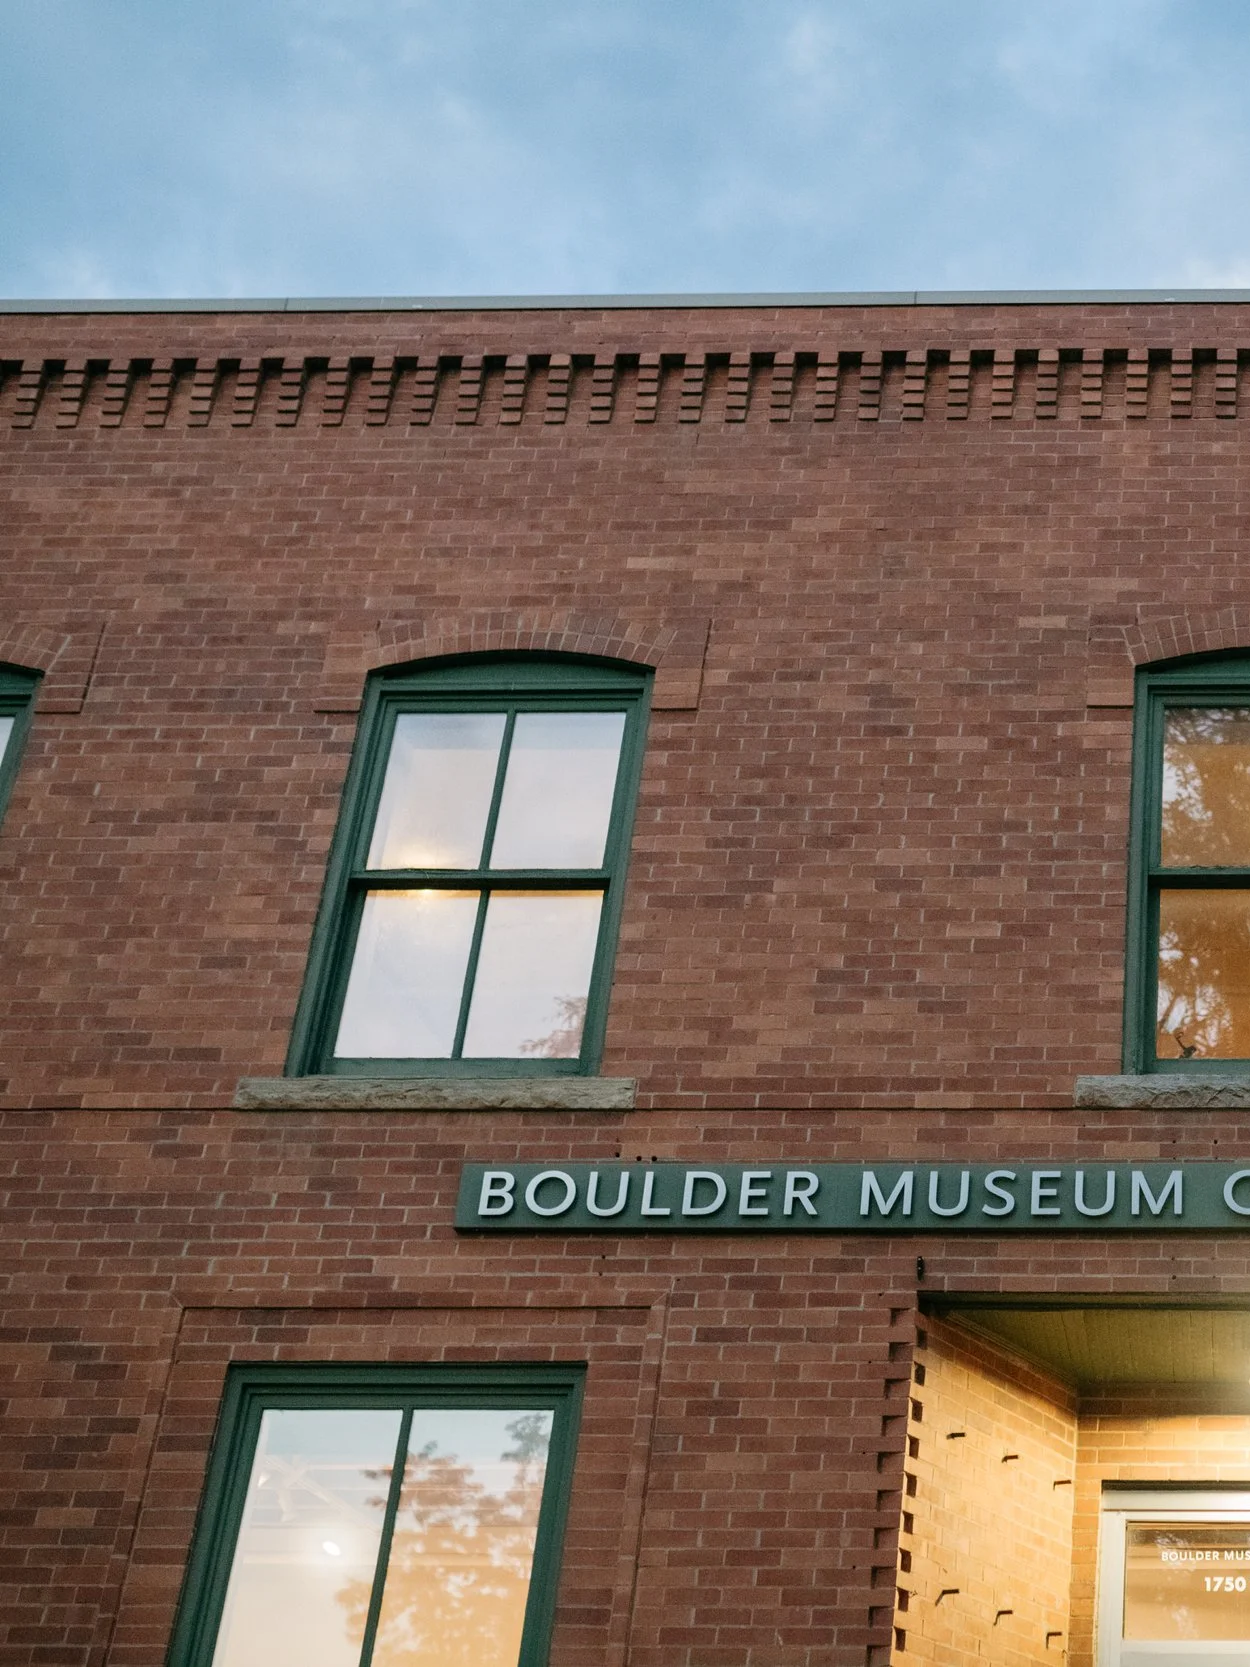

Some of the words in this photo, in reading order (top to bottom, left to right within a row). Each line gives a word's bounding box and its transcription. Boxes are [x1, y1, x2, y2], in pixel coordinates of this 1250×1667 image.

[477, 1170, 820, 1216] BOULDER
[858, 1170, 1185, 1216] MUSEUM
[1161, 1551, 1219, 1562] BOULDER
[1204, 1576, 1246, 1592] 1750
